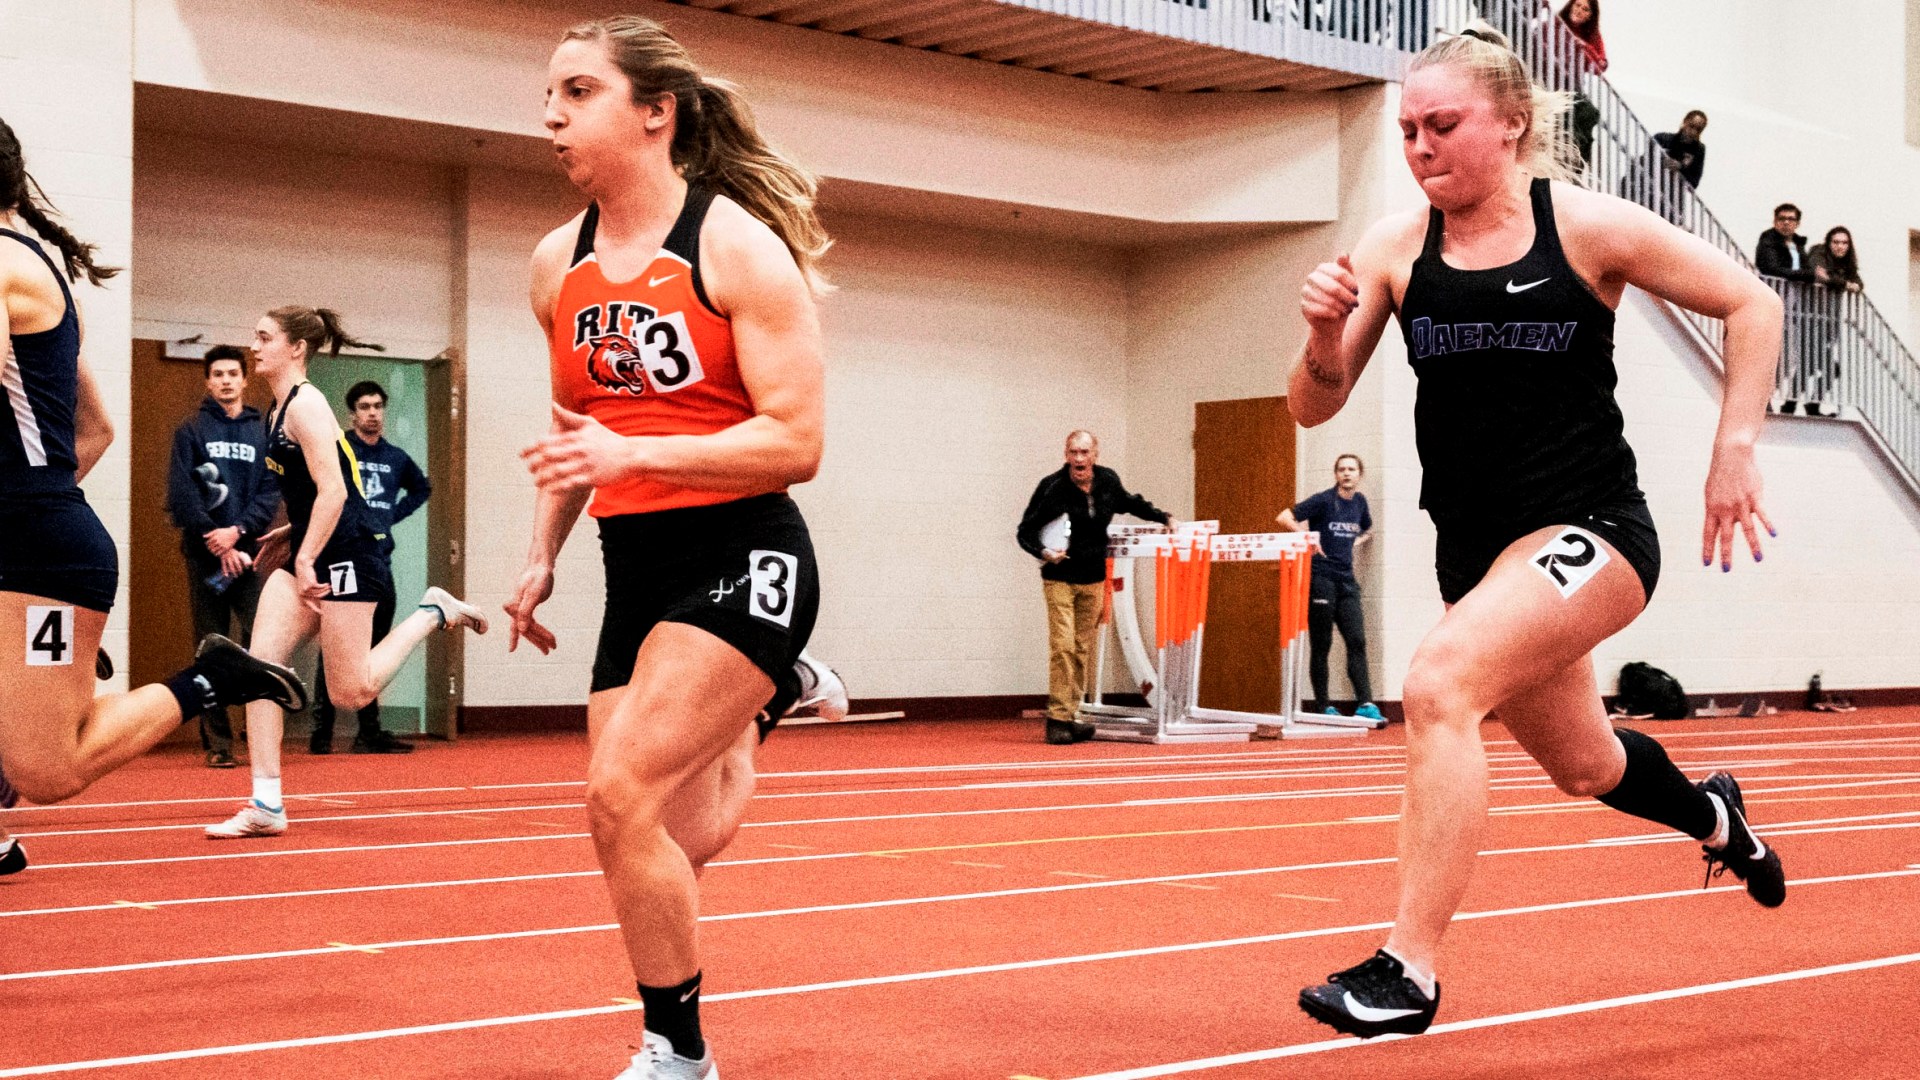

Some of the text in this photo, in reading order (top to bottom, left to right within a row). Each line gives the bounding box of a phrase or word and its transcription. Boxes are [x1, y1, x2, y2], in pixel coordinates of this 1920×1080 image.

[573, 301, 658, 351] RIT
[1412, 316, 1578, 359] DAEMEN
[644, 321, 691, 386] 3
[205, 441, 256, 462] GENSEO
[332, 565, 349, 593] 7
[1218, 550, 1240, 560] RIT
[1536, 533, 1596, 588] 2
[757, 555, 789, 617] 3
[32, 610, 67, 662] 4
